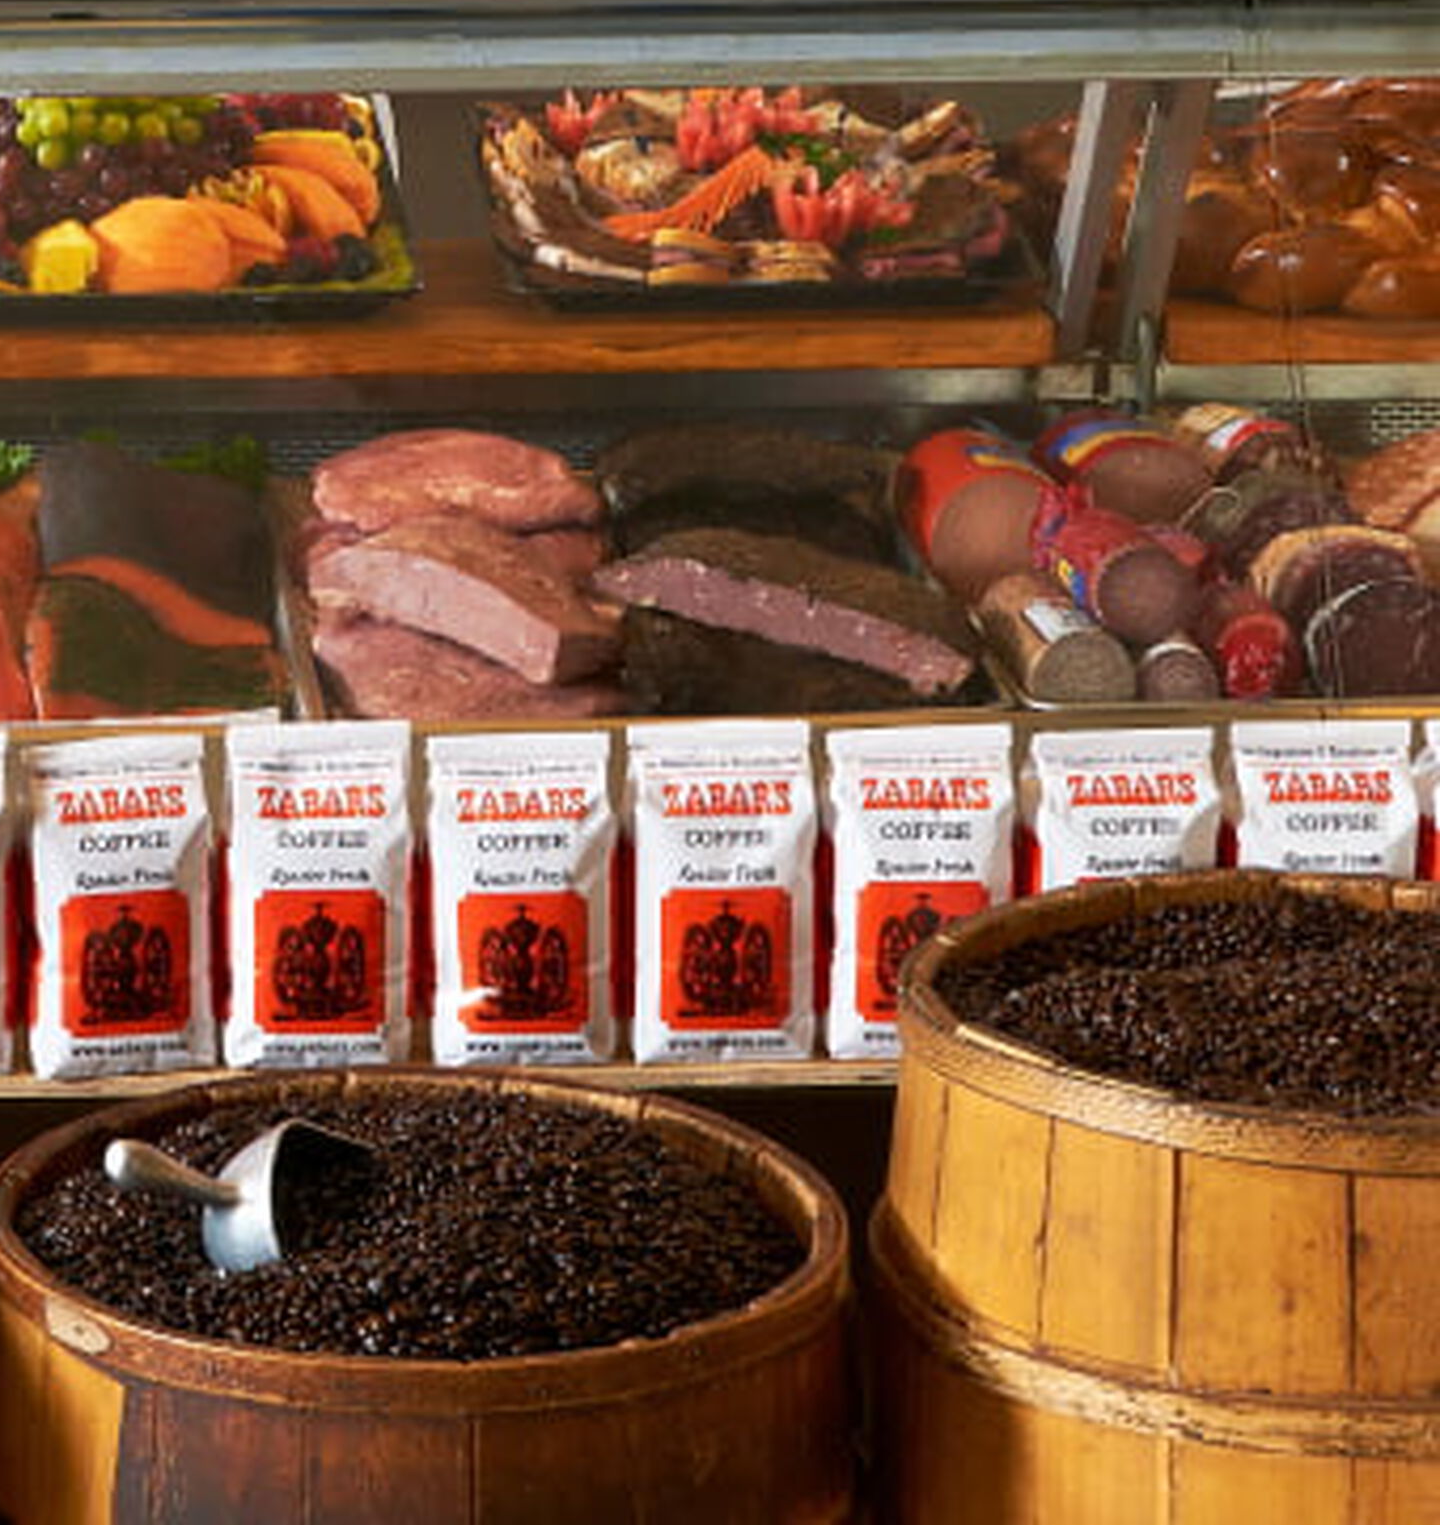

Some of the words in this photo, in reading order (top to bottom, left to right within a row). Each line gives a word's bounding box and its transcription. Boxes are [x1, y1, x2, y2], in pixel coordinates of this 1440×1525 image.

[258, 785, 388, 819] ZABARS
[662, 781, 792, 818] ZABARS
[860, 778, 991, 811] ZABARS
[1067, 773, 1197, 806] ZABARS
[1263, 770, 1394, 804] ZABARS
[57, 785, 188, 824] ZABARS
[458, 787, 589, 823] ZABARS
